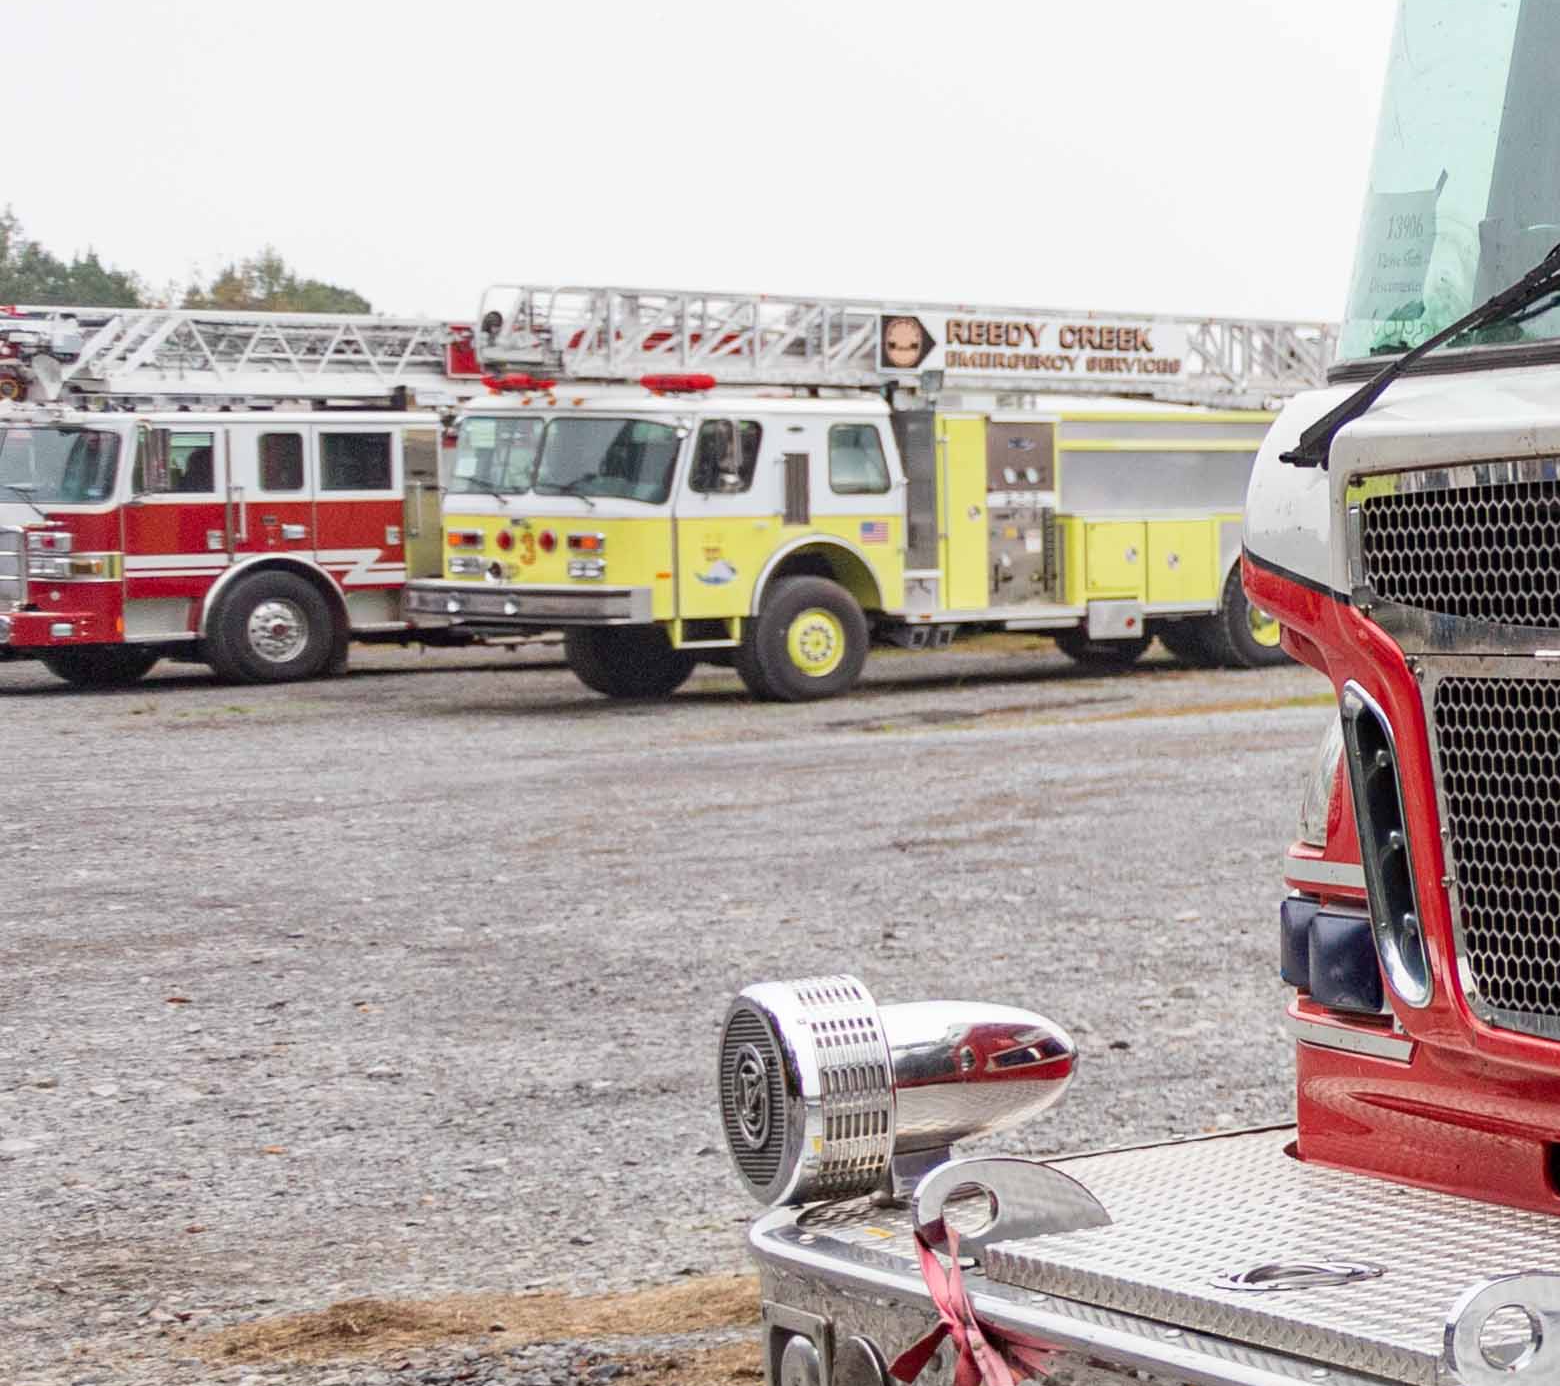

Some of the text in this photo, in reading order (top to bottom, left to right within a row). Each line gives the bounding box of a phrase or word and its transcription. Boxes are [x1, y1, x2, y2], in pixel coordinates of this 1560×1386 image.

[945, 319, 1154, 352] REEDY CREEK
[944, 351, 1182, 375] EMERGENCY SERVICES
